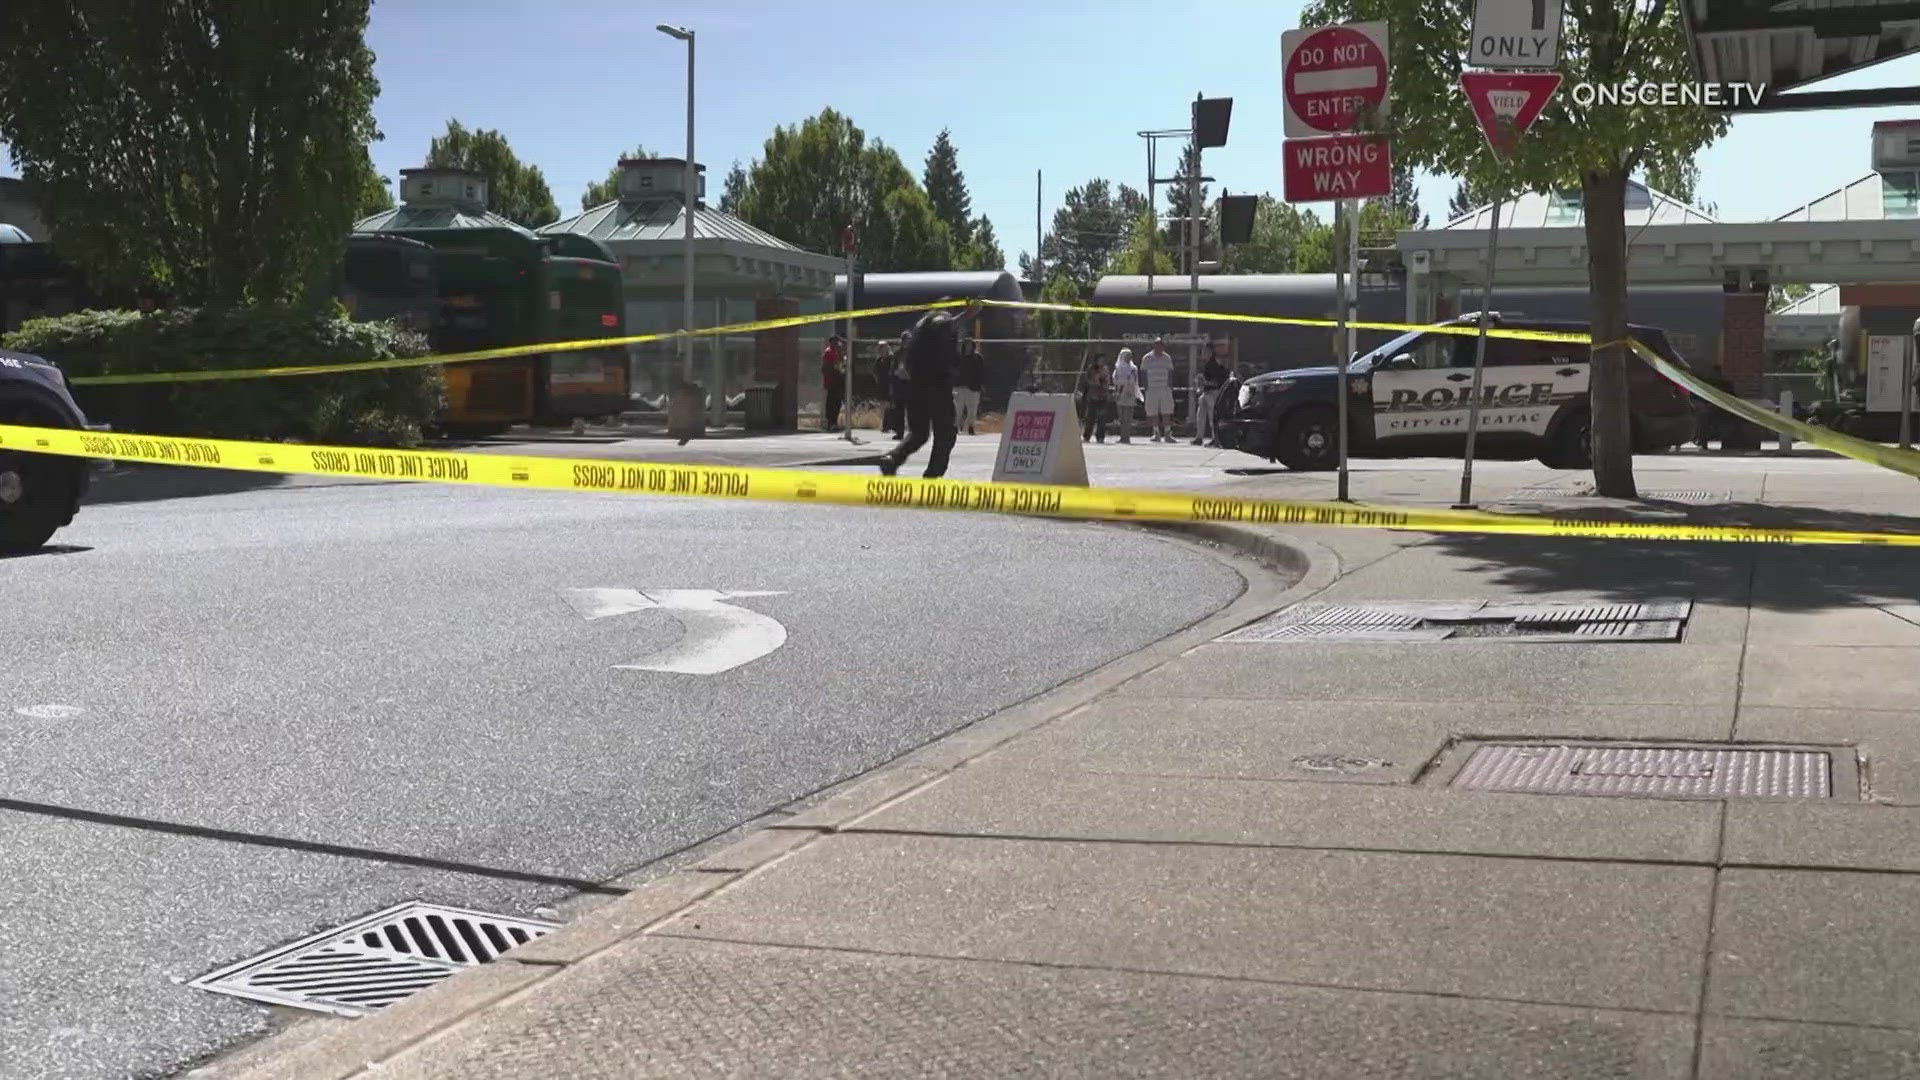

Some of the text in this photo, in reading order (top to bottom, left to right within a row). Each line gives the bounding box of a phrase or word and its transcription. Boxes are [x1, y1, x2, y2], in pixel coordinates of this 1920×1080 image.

[1301, 43, 1368, 66] DO NOT
[1480, 36, 1549, 58] ONLY
[1307, 95, 1365, 117] ENTER
[1493, 95, 1524, 108] YIELD
[1297, 143, 1378, 168] WRONG
[1313, 170, 1361, 193] WAY
[1388, 384, 1555, 412] POLICE
[1391, 412, 1540, 429] CITY OF EATAC
[80, 435, 220, 464] POLICE LINE DO NOT CROSS
[1012, 444, 1042, 456] BUSES
[311, 451, 468, 480] POLICE LINE DO NOT CROSS
[1013, 458, 1036, 468] ONLY
[573, 464, 748, 496] POLICE LINE DO NOT CROSS
[865, 480, 1063, 512] POLICE LINE DO NOT CROSS
[1192, 498, 1243, 521] CROSS
[1251, 502, 1280, 522] NOT
[1285, 505, 1306, 523] DO
[1313, 508, 1345, 524] LINE
